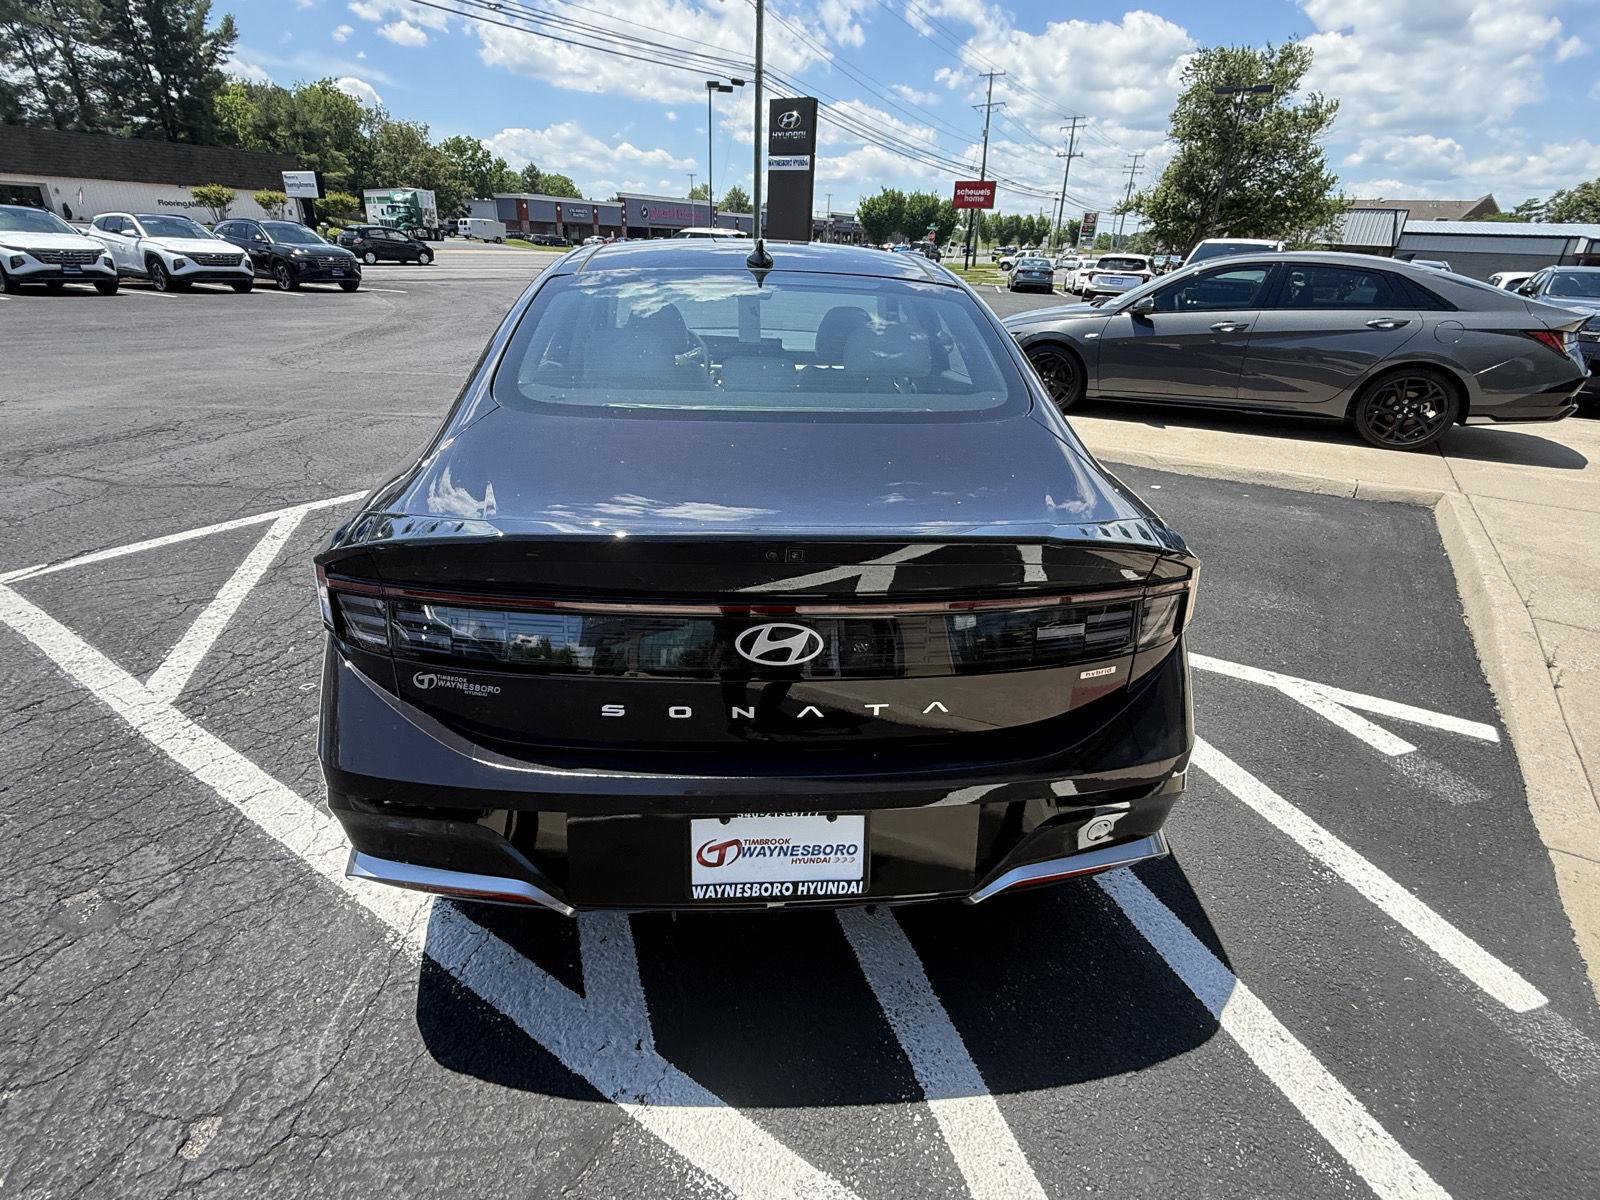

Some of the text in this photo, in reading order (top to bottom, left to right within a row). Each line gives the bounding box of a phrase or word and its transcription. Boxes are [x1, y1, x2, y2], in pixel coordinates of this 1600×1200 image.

[772, 130, 806, 139] HYUNDAI
[1085, 667, 1112, 678] hybrid
[437, 674, 468, 683] TIMBROOK
[437, 680, 501, 694] WAYNESBORO
[601, 701, 949, 719] SONATA
[743, 838, 792, 846] TIMBROOK
[741, 843, 858, 859] WAYNESBORO
[790, 857, 832, 866] HYUNDAI
[692, 880, 864, 900] WAYNESBORO HYUNDAI
